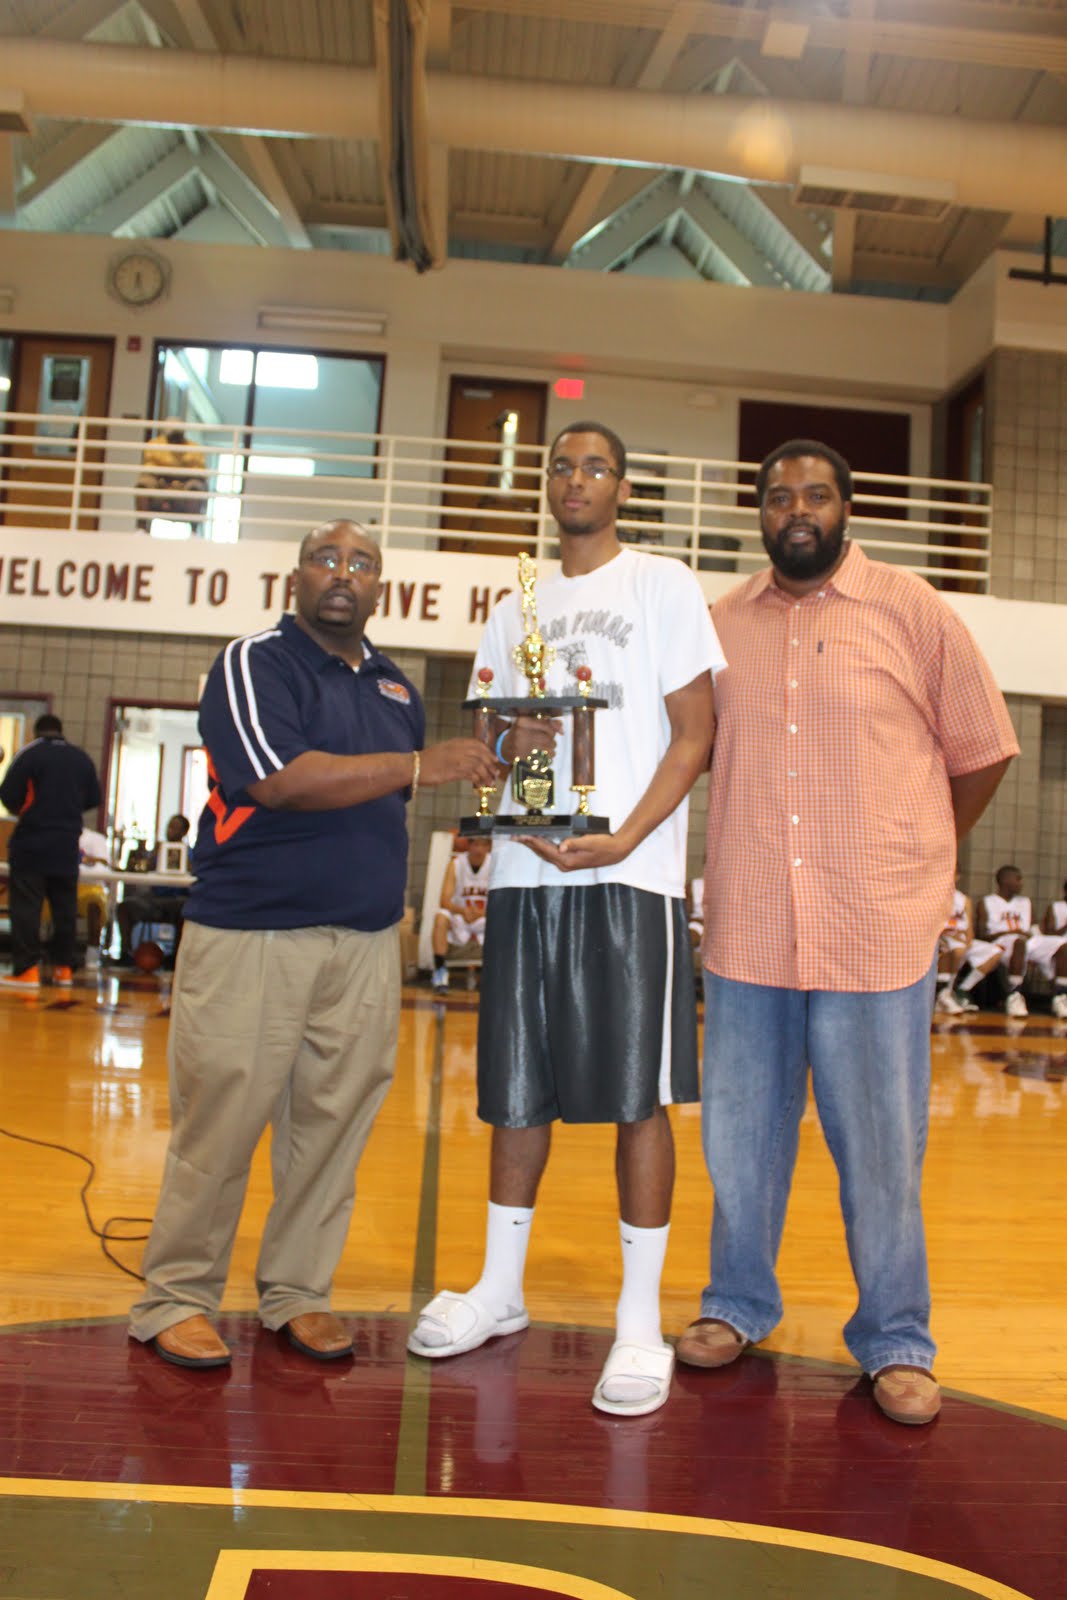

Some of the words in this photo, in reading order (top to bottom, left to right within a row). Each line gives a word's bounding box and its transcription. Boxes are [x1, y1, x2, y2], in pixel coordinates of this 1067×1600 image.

[0, 557, 154, 602] ELCOME
[186, 568, 228, 606] TO
[373, 581, 441, 621] IVE
